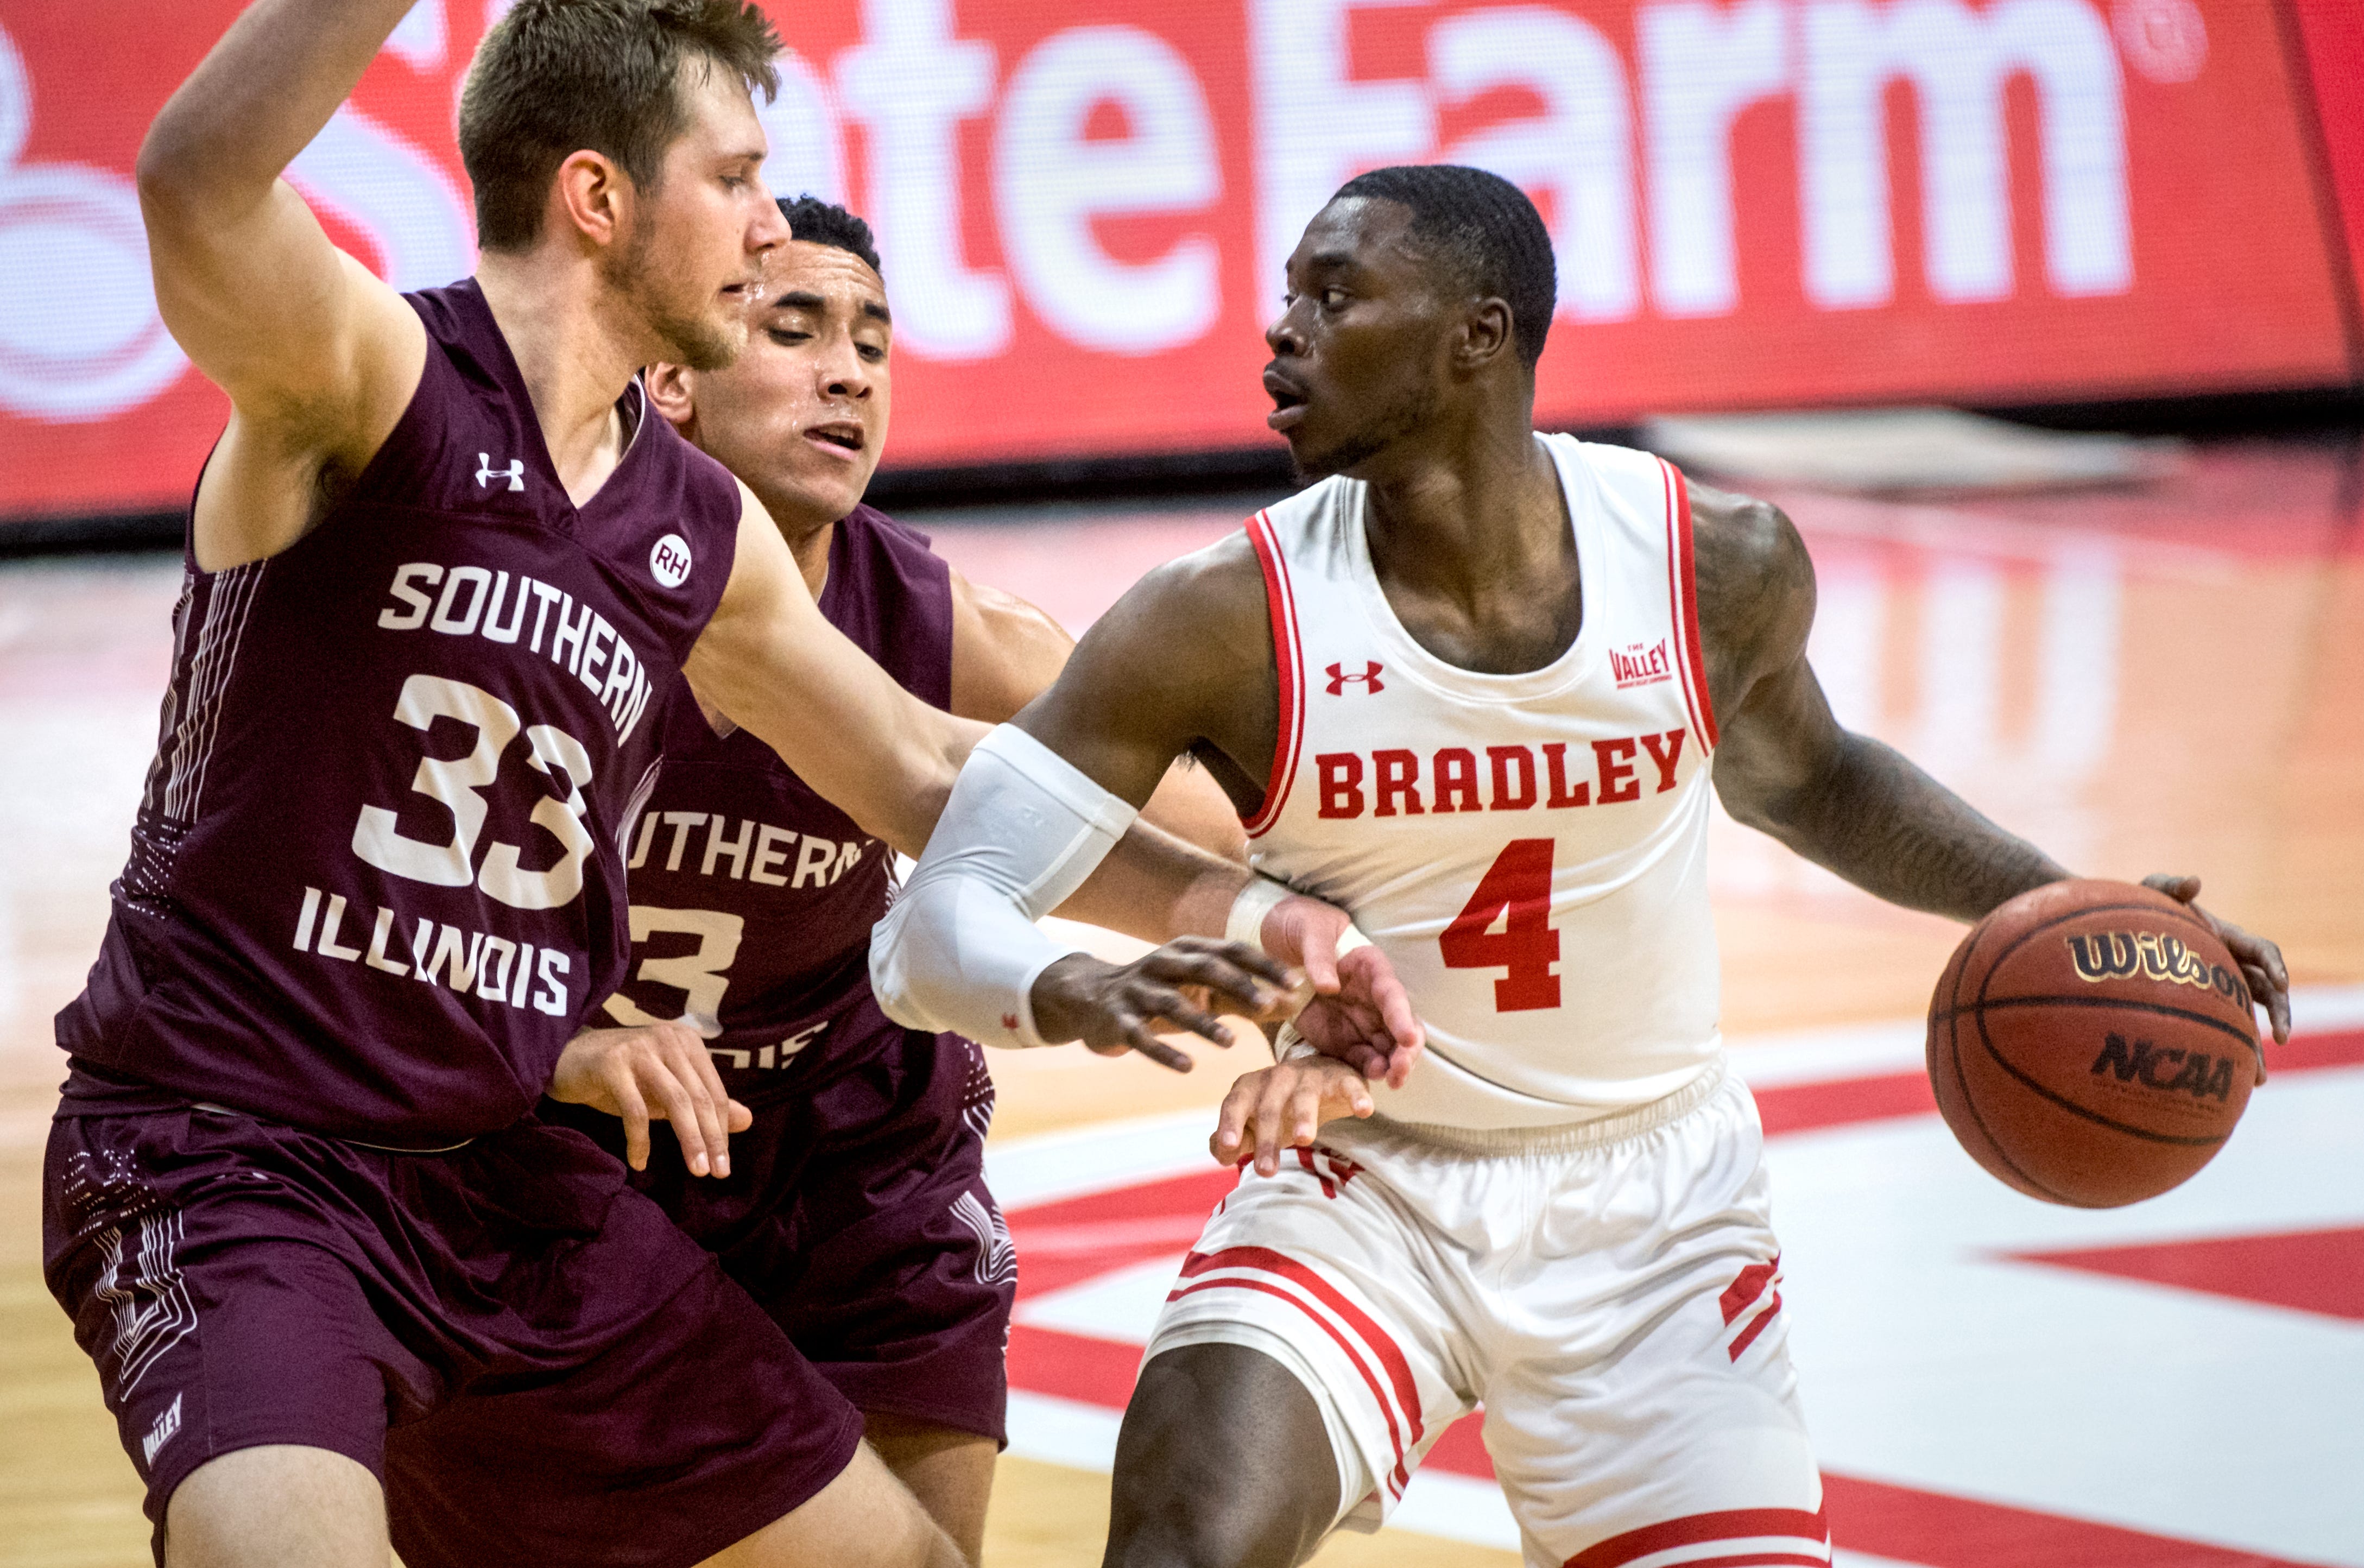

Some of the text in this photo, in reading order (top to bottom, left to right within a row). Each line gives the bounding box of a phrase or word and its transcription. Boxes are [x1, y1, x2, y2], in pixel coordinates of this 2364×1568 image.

[655, 543, 688, 580] RH
[378, 562, 652, 748] SOUTHERN
[1609, 637, 1669, 681] VALLEY
[352, 674, 595, 910] 33
[1315, 728, 1686, 819] BRADLEY
[293, 886, 571, 1017] ILLINOIS
[1439, 838, 1562, 1013] 4
[2065, 930, 2253, 1017] Wilson
[2090, 1031, 2235, 1102] NCAA
[143, 1392, 183, 1466] VALLEY
